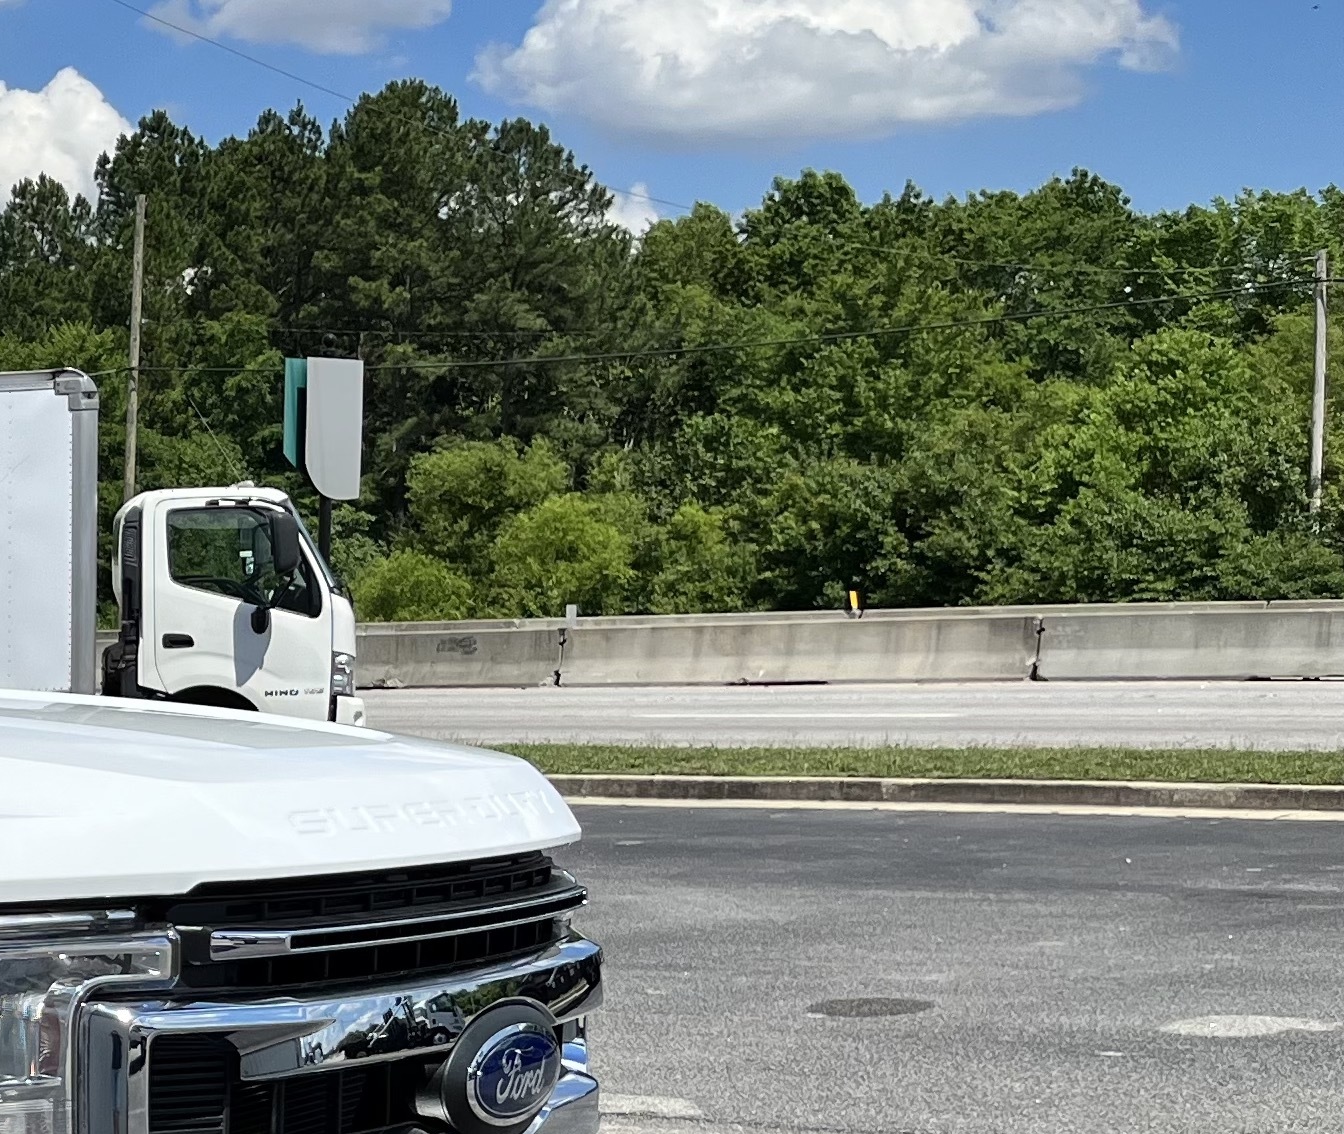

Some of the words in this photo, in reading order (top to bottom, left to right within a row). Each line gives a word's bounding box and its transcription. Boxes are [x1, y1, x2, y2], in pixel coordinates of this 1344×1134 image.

[264, 689, 299, 697] HINO
[287, 800, 465, 837] SUPER
[464, 789, 556, 825] DUTY
[496, 1045, 546, 1105] Ford
